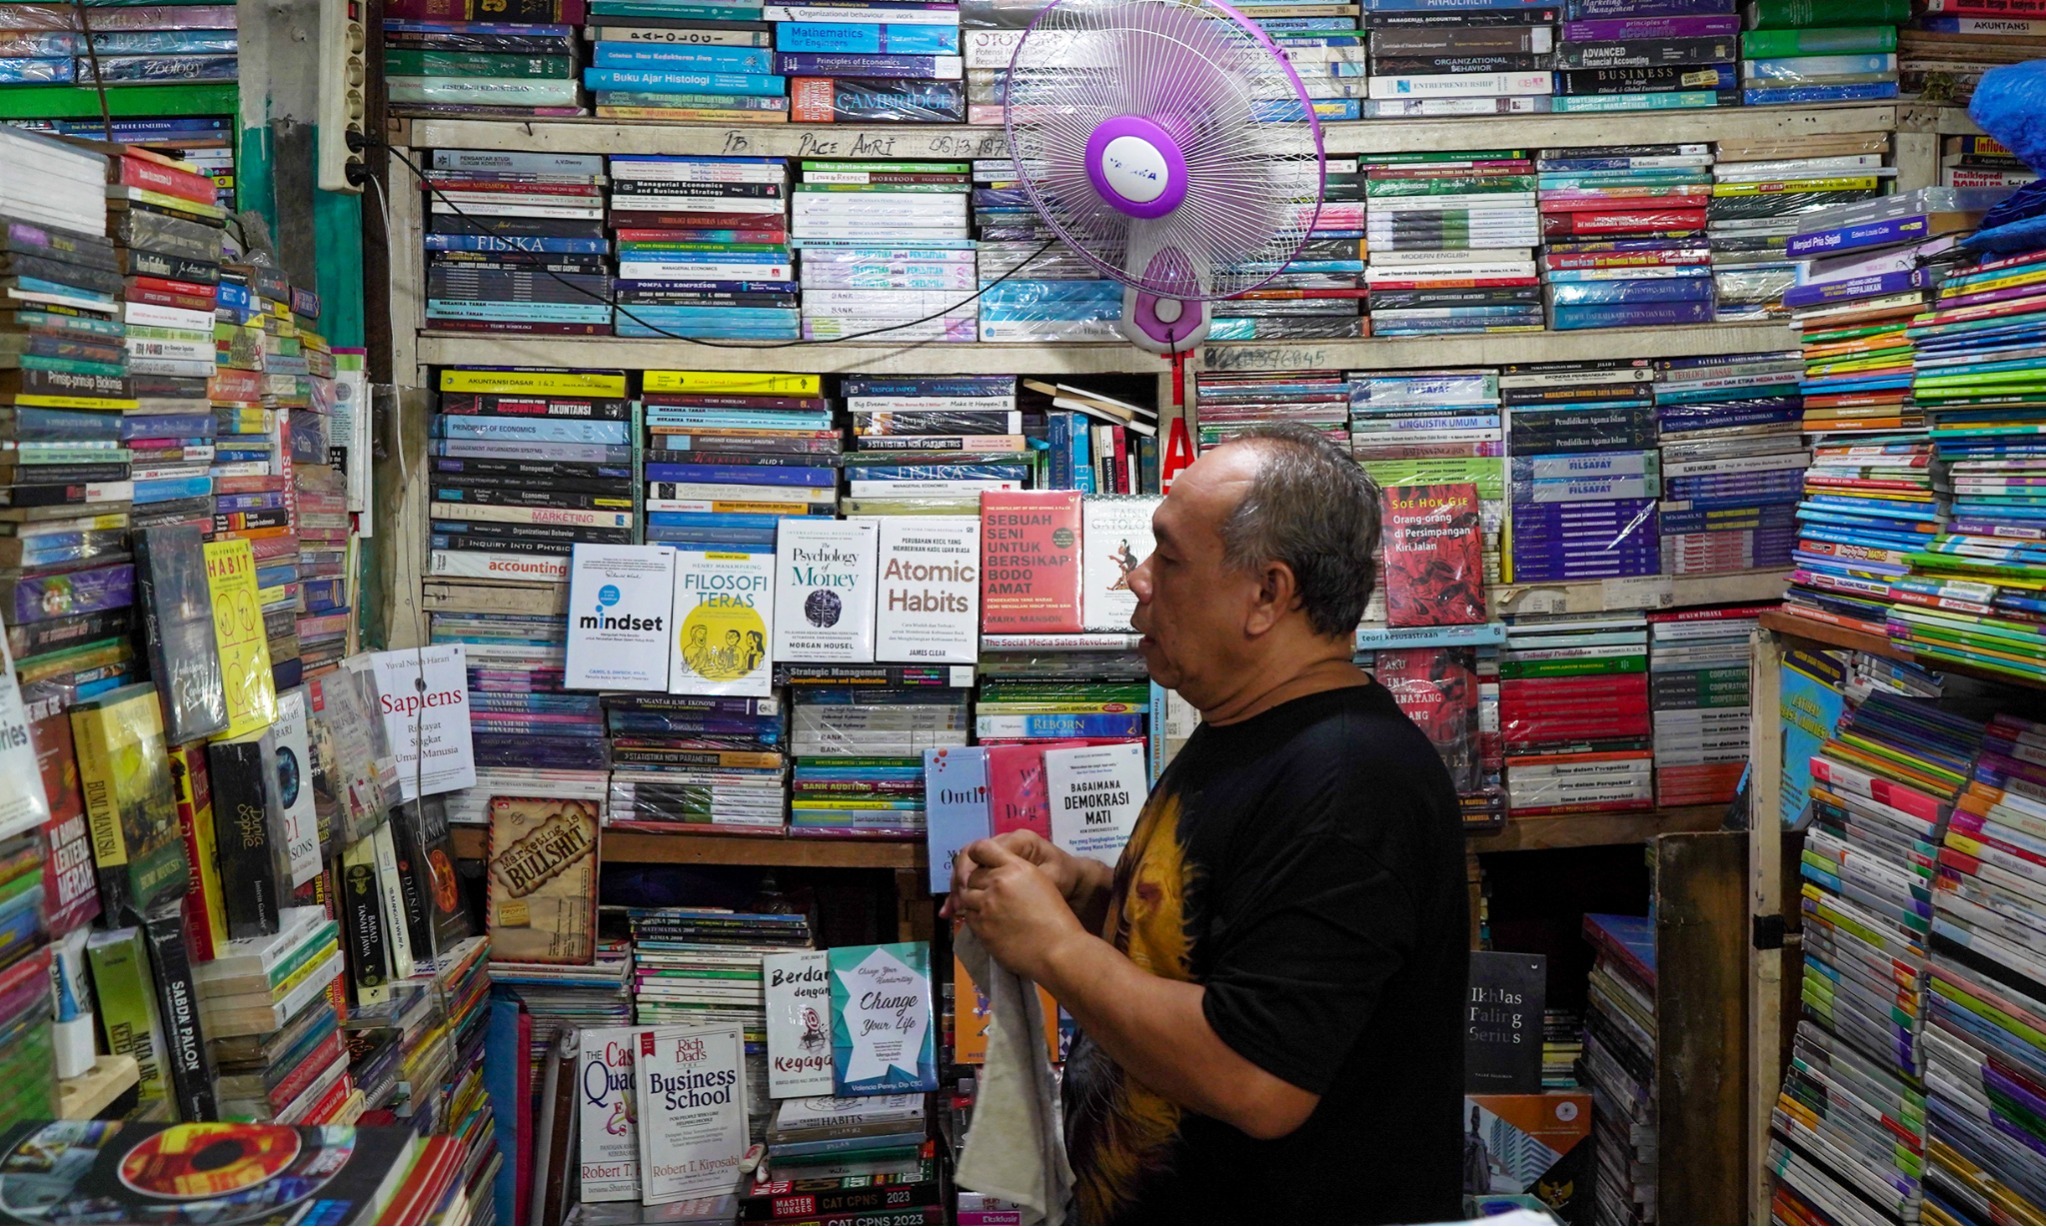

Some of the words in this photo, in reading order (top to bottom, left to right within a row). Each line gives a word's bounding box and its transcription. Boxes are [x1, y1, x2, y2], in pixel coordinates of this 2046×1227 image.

[791, 26, 863, 39] Mathematics
[1974, 22, 2030, 31] AKUNTANSI
[804, 39, 848, 48] Engineers
[1583, 47, 1626, 58] ADVANCED
[817, 57, 850, 66] Principles
[861, 57, 900, 66] Economics
[1434, 57, 1508, 66] ORGANIZATIONAL
[1451, 64, 1492, 72] BEHAVIOR
[1598, 68, 1674, 80] BUSINESS
[613, 72, 641, 82] Buku
[643, 74, 664, 84] Ajar
[665, 75, 710, 85] Histologi
[1413, 80, 1494, 89] ENTREPRENEURSHIP
[836, 93, 951, 110] CAMBRIDGE
[477, 236, 544, 251] FISIKA
[1813, 236, 1823, 247] Pria
[96, 375, 122, 391] Biokimia
[468, 378, 509, 386] AKUNTANSI
[548, 404, 591, 415] AKUNTANSI
[1399, 420, 1447, 429] LINGUISTIK
[1450, 419, 1478, 428] UMUM
[1590, 416, 1609, 425] Agama
[1610, 415, 1627, 423] Islam
[1569, 460, 1612, 470] FILSAFAT
[1569, 485, 1612, 494] FILSAFAT
[532, 511, 594, 523] MARKETING
[987, 515, 1052, 526] SEBUAH
[1393, 514, 1452, 525] Orang-orang
[987, 529, 1023, 539] SENI
[1394, 529, 1403, 538] di
[1405, 527, 1470, 538] Persimpangan
[537, 544, 574, 552] PHYSIC
[987, 542, 1041, 553] UNTUK
[1396, 543, 1411, 552] Kiri
[1412, 542, 1436, 551] Jalan
[793, 548, 859, 567] Psychology
[987, 555, 1069, 567] BERSIKAP
[207, 554, 250, 577] HABIT
[489, 560, 567, 576] accounting
[822, 563, 830, 572] of
[884, 558, 976, 582] Atomic
[792, 566, 859, 591] Money
[988, 569, 1033, 581] BODO
[684, 574, 767, 591] FILOSOFI
[987, 583, 1032, 594] AMAT
[696, 592, 754, 608] TERAS
[888, 589, 969, 613] Habits
[987, 615, 1016, 623] MARK
[1678, 611, 1698, 620] HUKUM
[580, 613, 663, 631] mindset
[1001, 638, 1026, 646] Social
[1028, 638, 1053, 646] Media
[1362, 634, 1383, 642] teori
[1384, 632, 1438, 640] kesusastraan
[1385, 660, 1407, 670] AKU
[790, 668, 829, 677] Strategic
[831, 668, 887, 677] Management
[380, 689, 463, 717] Sapiens
[1395, 694, 1442, 703] INATANG
[422, 747, 458, 759] Manusia
[1071, 781, 1121, 793] BAGAIMANA
[1064, 792, 1129, 810] DEMOKRASI
[1005, 804, 1037, 821] Dog
[1085, 810, 1112, 825] MATI
[500, 824, 565, 870] Marketing
[566, 814, 580, 828] is
[357, 902, 369, 939] TANAH
[368, 914, 378, 943] BABAD
[1471, 987, 1522, 1005] Ikhlas
[860, 992, 918, 1017] Change
[172, 980, 191, 1024] SABDA
[182, 1028, 199, 1071] PALON
[860, 1019, 892, 1037] Your
[896, 1016, 916, 1035] Life
[678, 1038, 704, 1051] Rich
[586, 1051, 602, 1060] THE
[676, 1050, 707, 1063] Dad's
[650, 1069, 736, 1095] Business
[665, 1085, 731, 1111] School
[822, 1114, 863, 1126] HABITS
[582, 1165, 620, 1179] Robert
[624, 1164, 632, 1177] T.
[653, 1164, 686, 1178] Robert
[689, 1162, 697, 1172] T.
[700, 1155, 740, 1173] Kiyosaki
[776, 1198, 812, 1208] MASTER
[823, 1197, 845, 1209] CAT
[848, 1194, 878, 1207] CPNS
[887, 1192, 910, 1203] 2023
[776, 1206, 812, 1214] SUKSES
[892, 1214, 924, 1225] 2023
